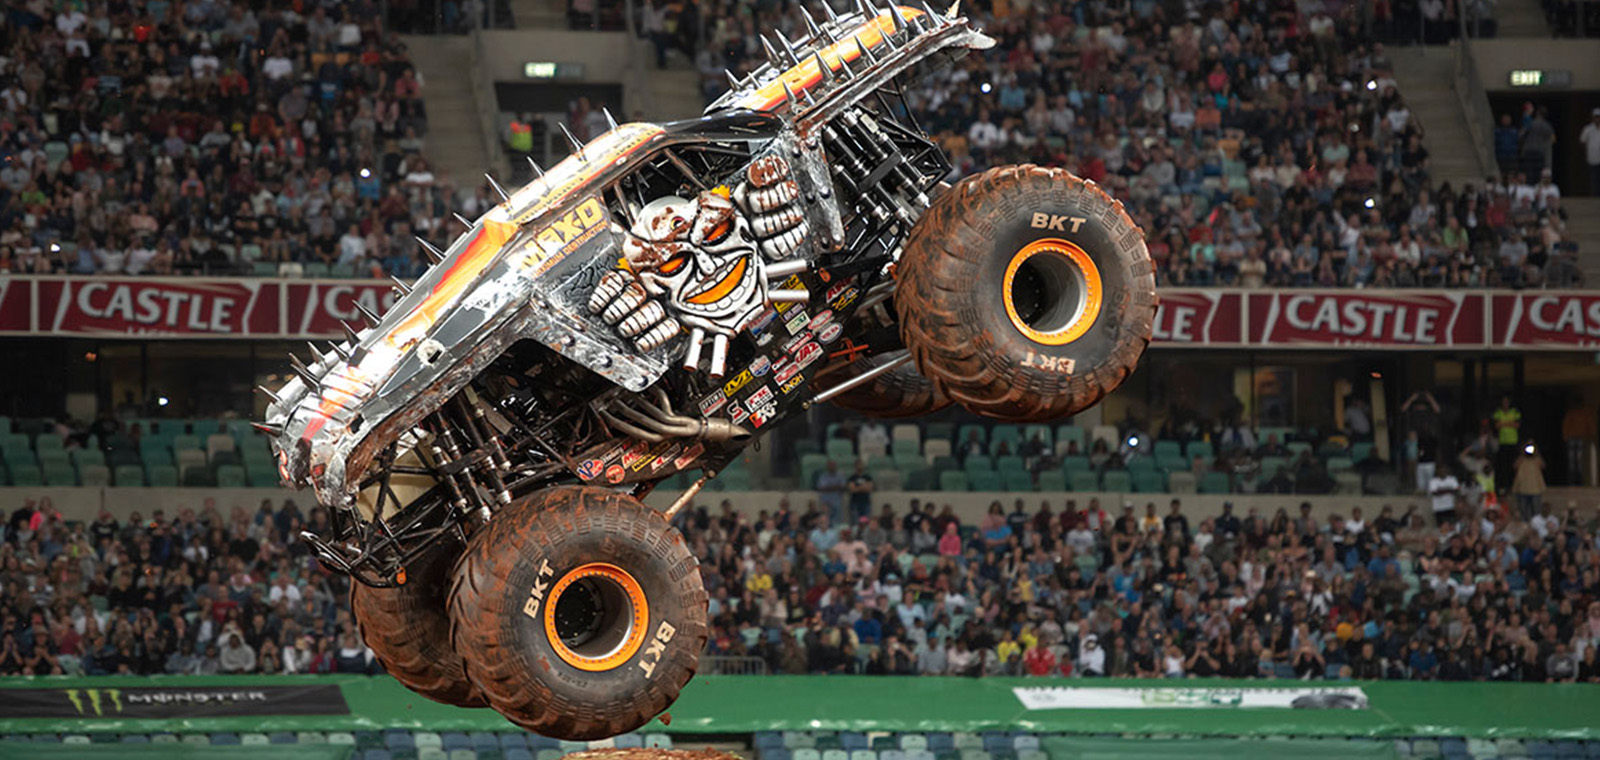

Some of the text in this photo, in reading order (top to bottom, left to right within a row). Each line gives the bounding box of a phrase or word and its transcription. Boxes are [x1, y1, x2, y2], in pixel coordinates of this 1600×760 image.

[1511, 70, 1541, 85] EXIT
[1031, 212, 1087, 233] BKT
[77, 282, 236, 332] CASTLE
[1286, 295, 1439, 343] CASTLE
[1020, 351, 1076, 375] BKT
[523, 558, 554, 619] BKT
[638, 620, 676, 679] BKT
